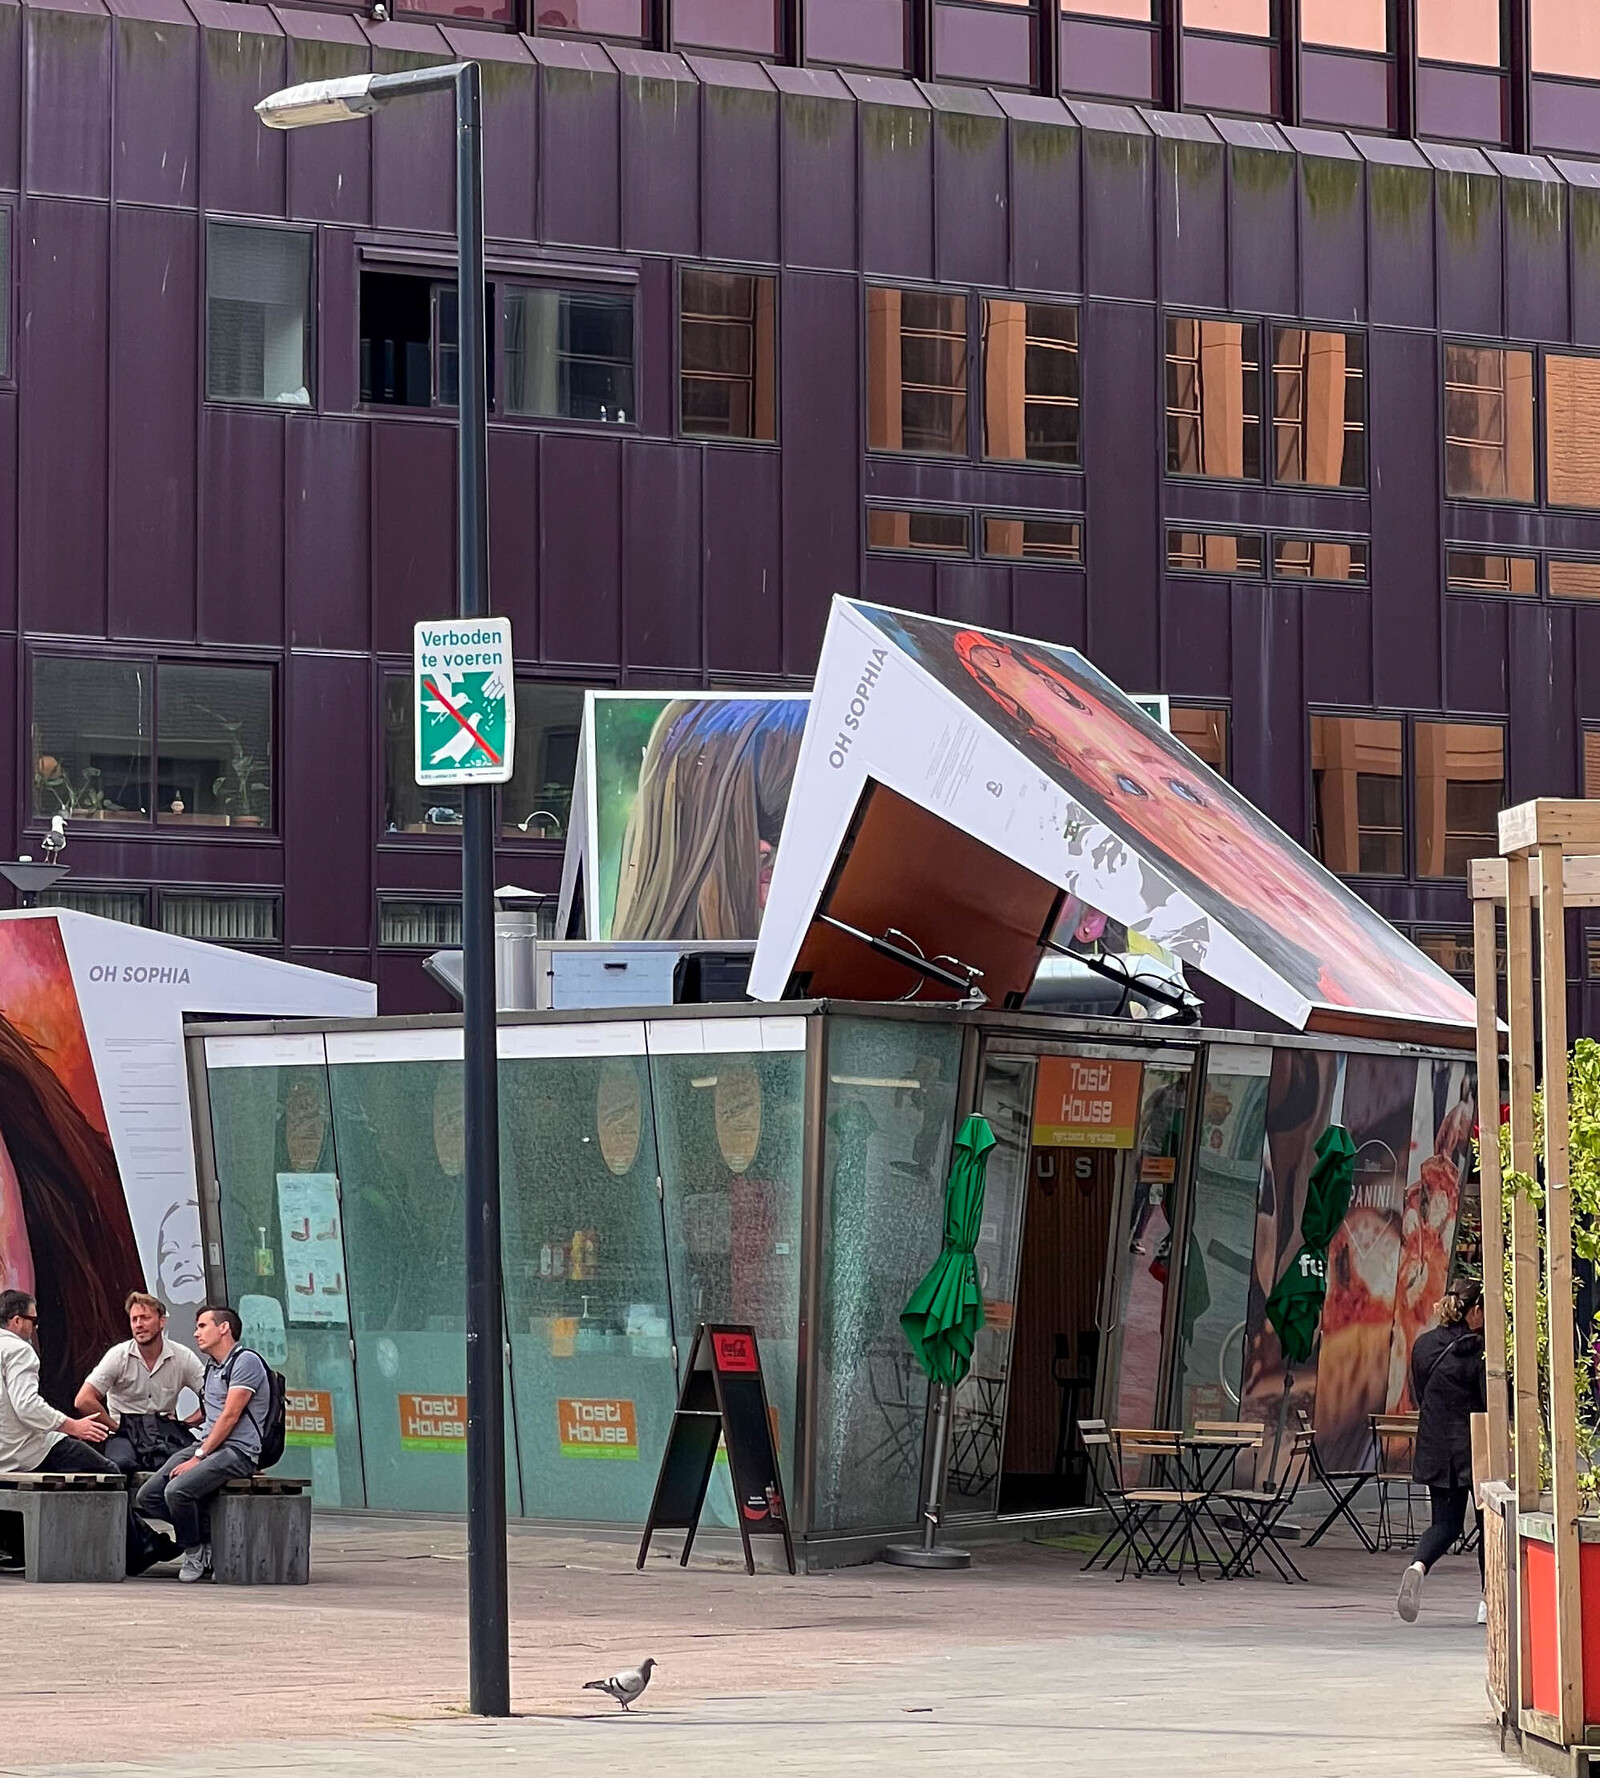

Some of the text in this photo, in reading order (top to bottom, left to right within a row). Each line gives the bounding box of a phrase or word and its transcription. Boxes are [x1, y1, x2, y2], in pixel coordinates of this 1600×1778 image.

[421, 629, 502, 647] Verboden
[421, 652, 503, 668] te voeren
[829, 648, 888, 769] OH SOPHIA
[89, 965, 191, 984] OH SOPHIA
[1070, 1062, 1112, 1092] Tosti
[285, 1393, 320, 1412] osti
[411, 1396, 458, 1417] Tosti
[570, 1401, 622, 1422] Tosti
[285, 1415, 326, 1432] ouse
